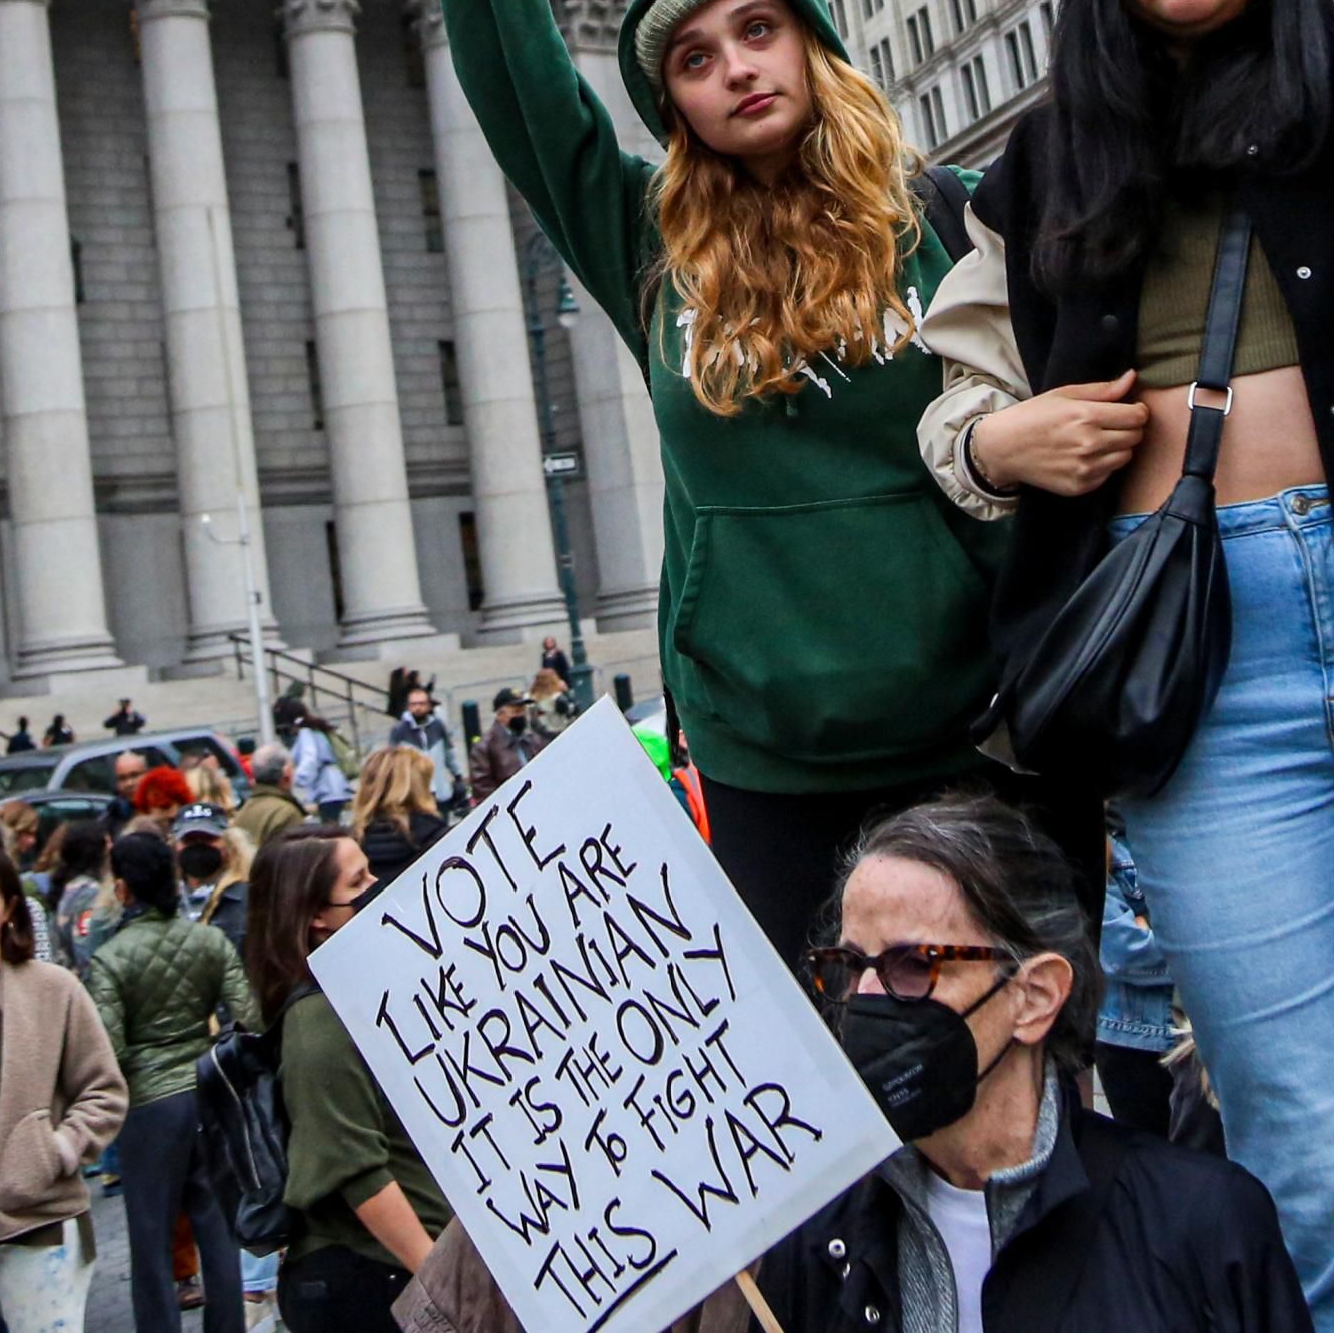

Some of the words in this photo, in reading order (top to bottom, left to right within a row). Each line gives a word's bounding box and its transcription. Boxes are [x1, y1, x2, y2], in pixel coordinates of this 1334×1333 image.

[376, 963, 477, 1065] LIKE
[463, 894, 551, 988] YOU
[557, 823, 637, 927] ARE
[381, 779, 565, 960] VOTE
[414, 863, 691, 1128] UKRAINIAN
[451, 1113, 511, 1194] IT
[509, 1077, 563, 1145] IS
[555, 1031, 624, 1107] THE
[616, 924, 737, 1066] ONLY
[485, 1140, 580, 1246] WAY
[623, 1018, 748, 1152] FIGHT
[534, 1198, 659, 1319] THIS
[651, 1082, 823, 1232] WAR
